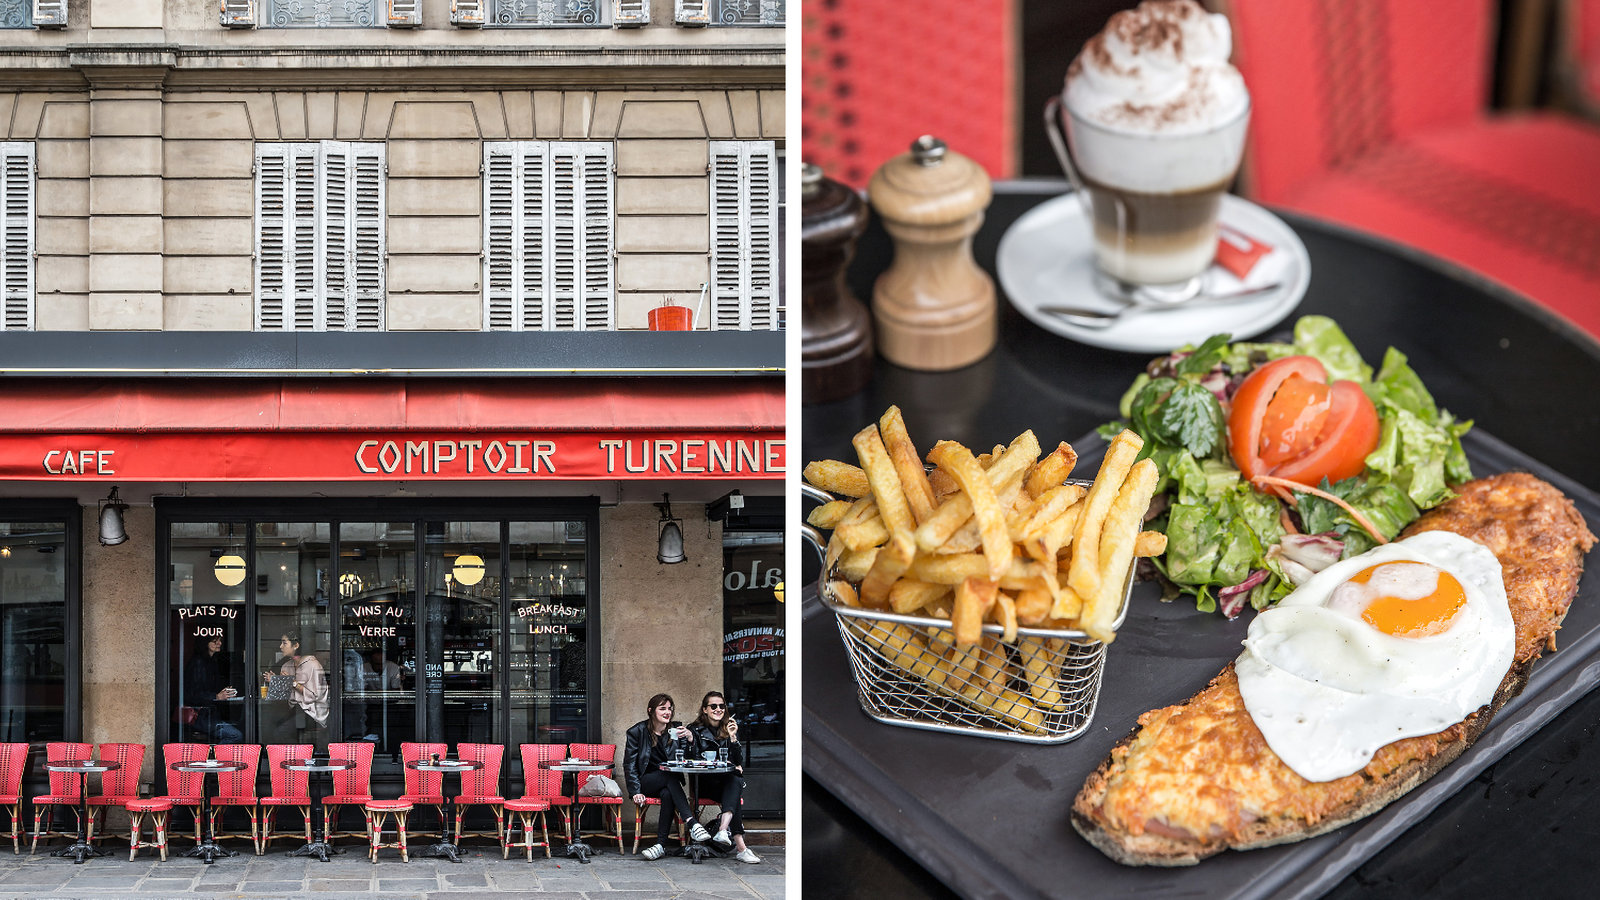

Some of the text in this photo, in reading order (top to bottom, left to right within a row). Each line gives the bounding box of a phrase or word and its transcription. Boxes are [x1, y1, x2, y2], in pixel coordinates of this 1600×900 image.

[42, 450, 116, 475] CAFE
[355, 440, 786, 474] COMPTOIR TURENNE
[178, 606, 238, 619] PLATS DU
[352, 605, 404, 618] VINS AU
[517, 604, 580, 618] BREAKFAST
[193, 625, 223, 637] JOUR
[359, 625, 396, 637] VERRE
[529, 624, 568, 635] LUNCH
